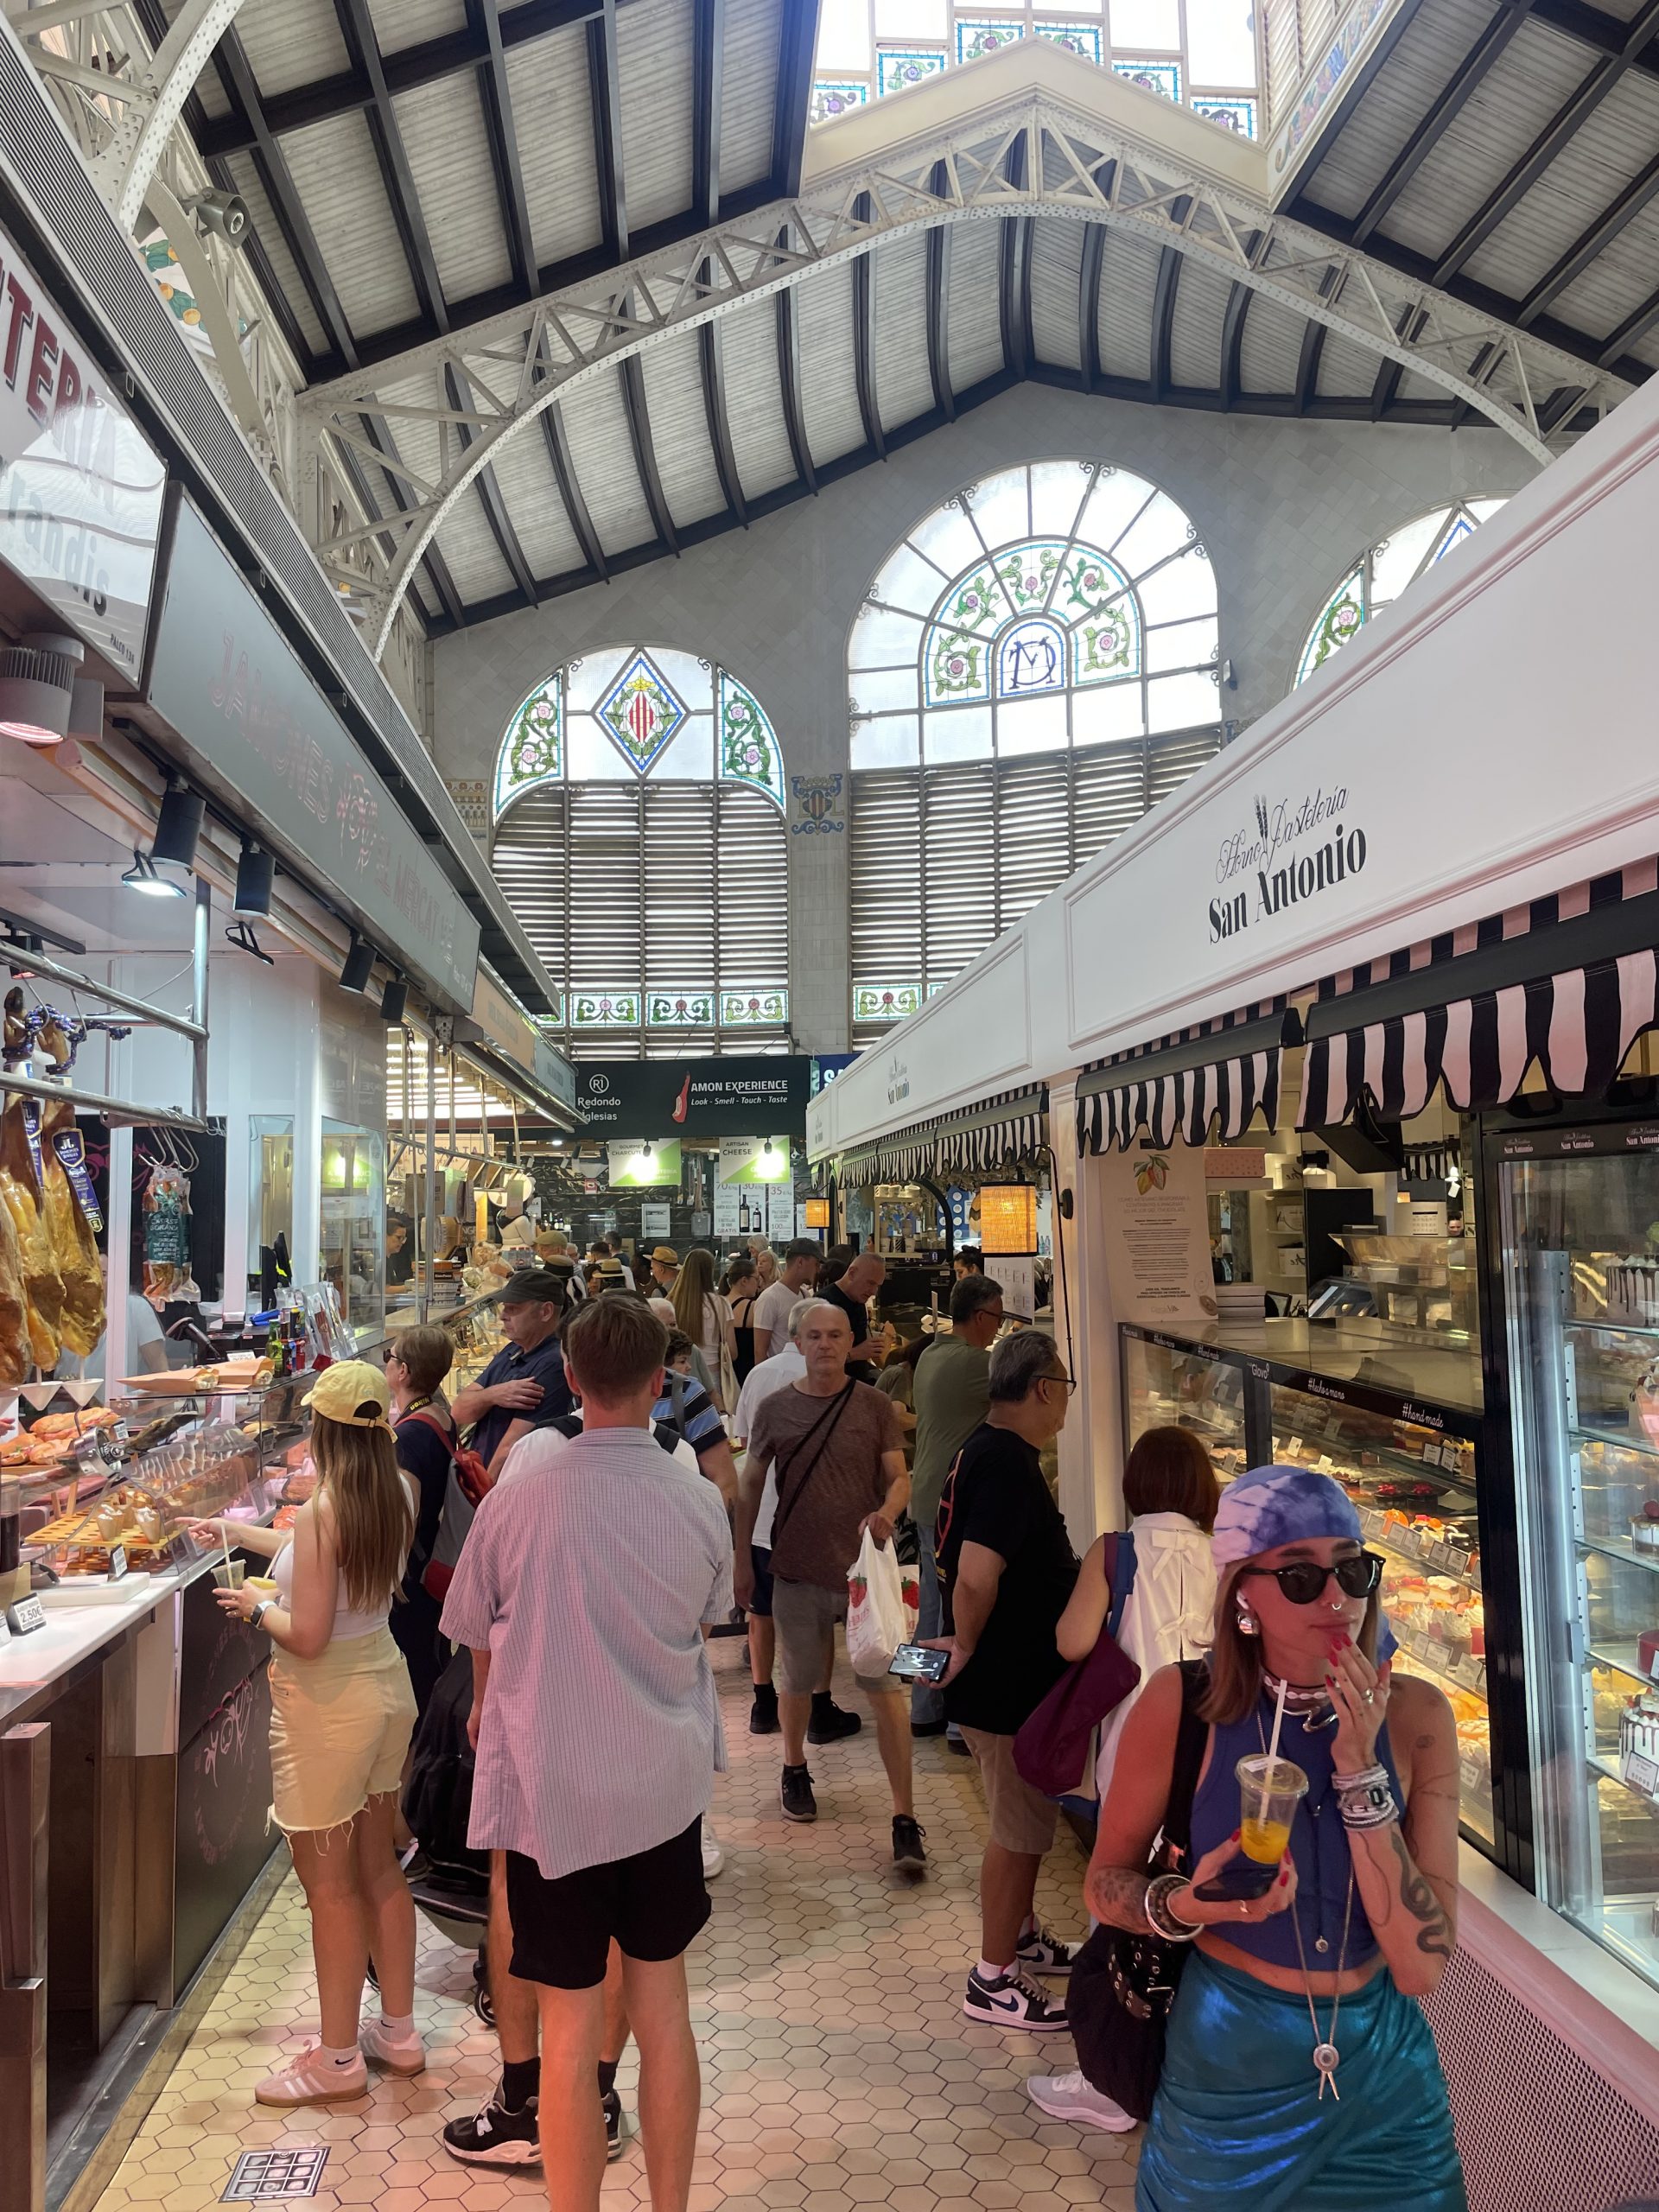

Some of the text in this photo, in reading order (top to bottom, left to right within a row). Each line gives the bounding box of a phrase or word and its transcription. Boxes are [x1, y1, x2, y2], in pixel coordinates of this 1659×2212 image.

[1216, 829, 1262, 884] Horno
[1209, 823, 1367, 945] San Antonio
[725, 1079, 788, 1093] EXPERIENCE
[577, 1096, 621, 1109] Redondo
[715, 1096, 735, 1105] Smell
[741, 1096, 761, 1104] Touch
[768, 1095, 788, 1103] Taste
[1560, 1141, 1572, 1150] San
[1626, 1134, 1659, 1146] San Antoni
[1251, 1363, 1269, 1380] Glovo
[410, 1396, 430, 1411] Nikon
